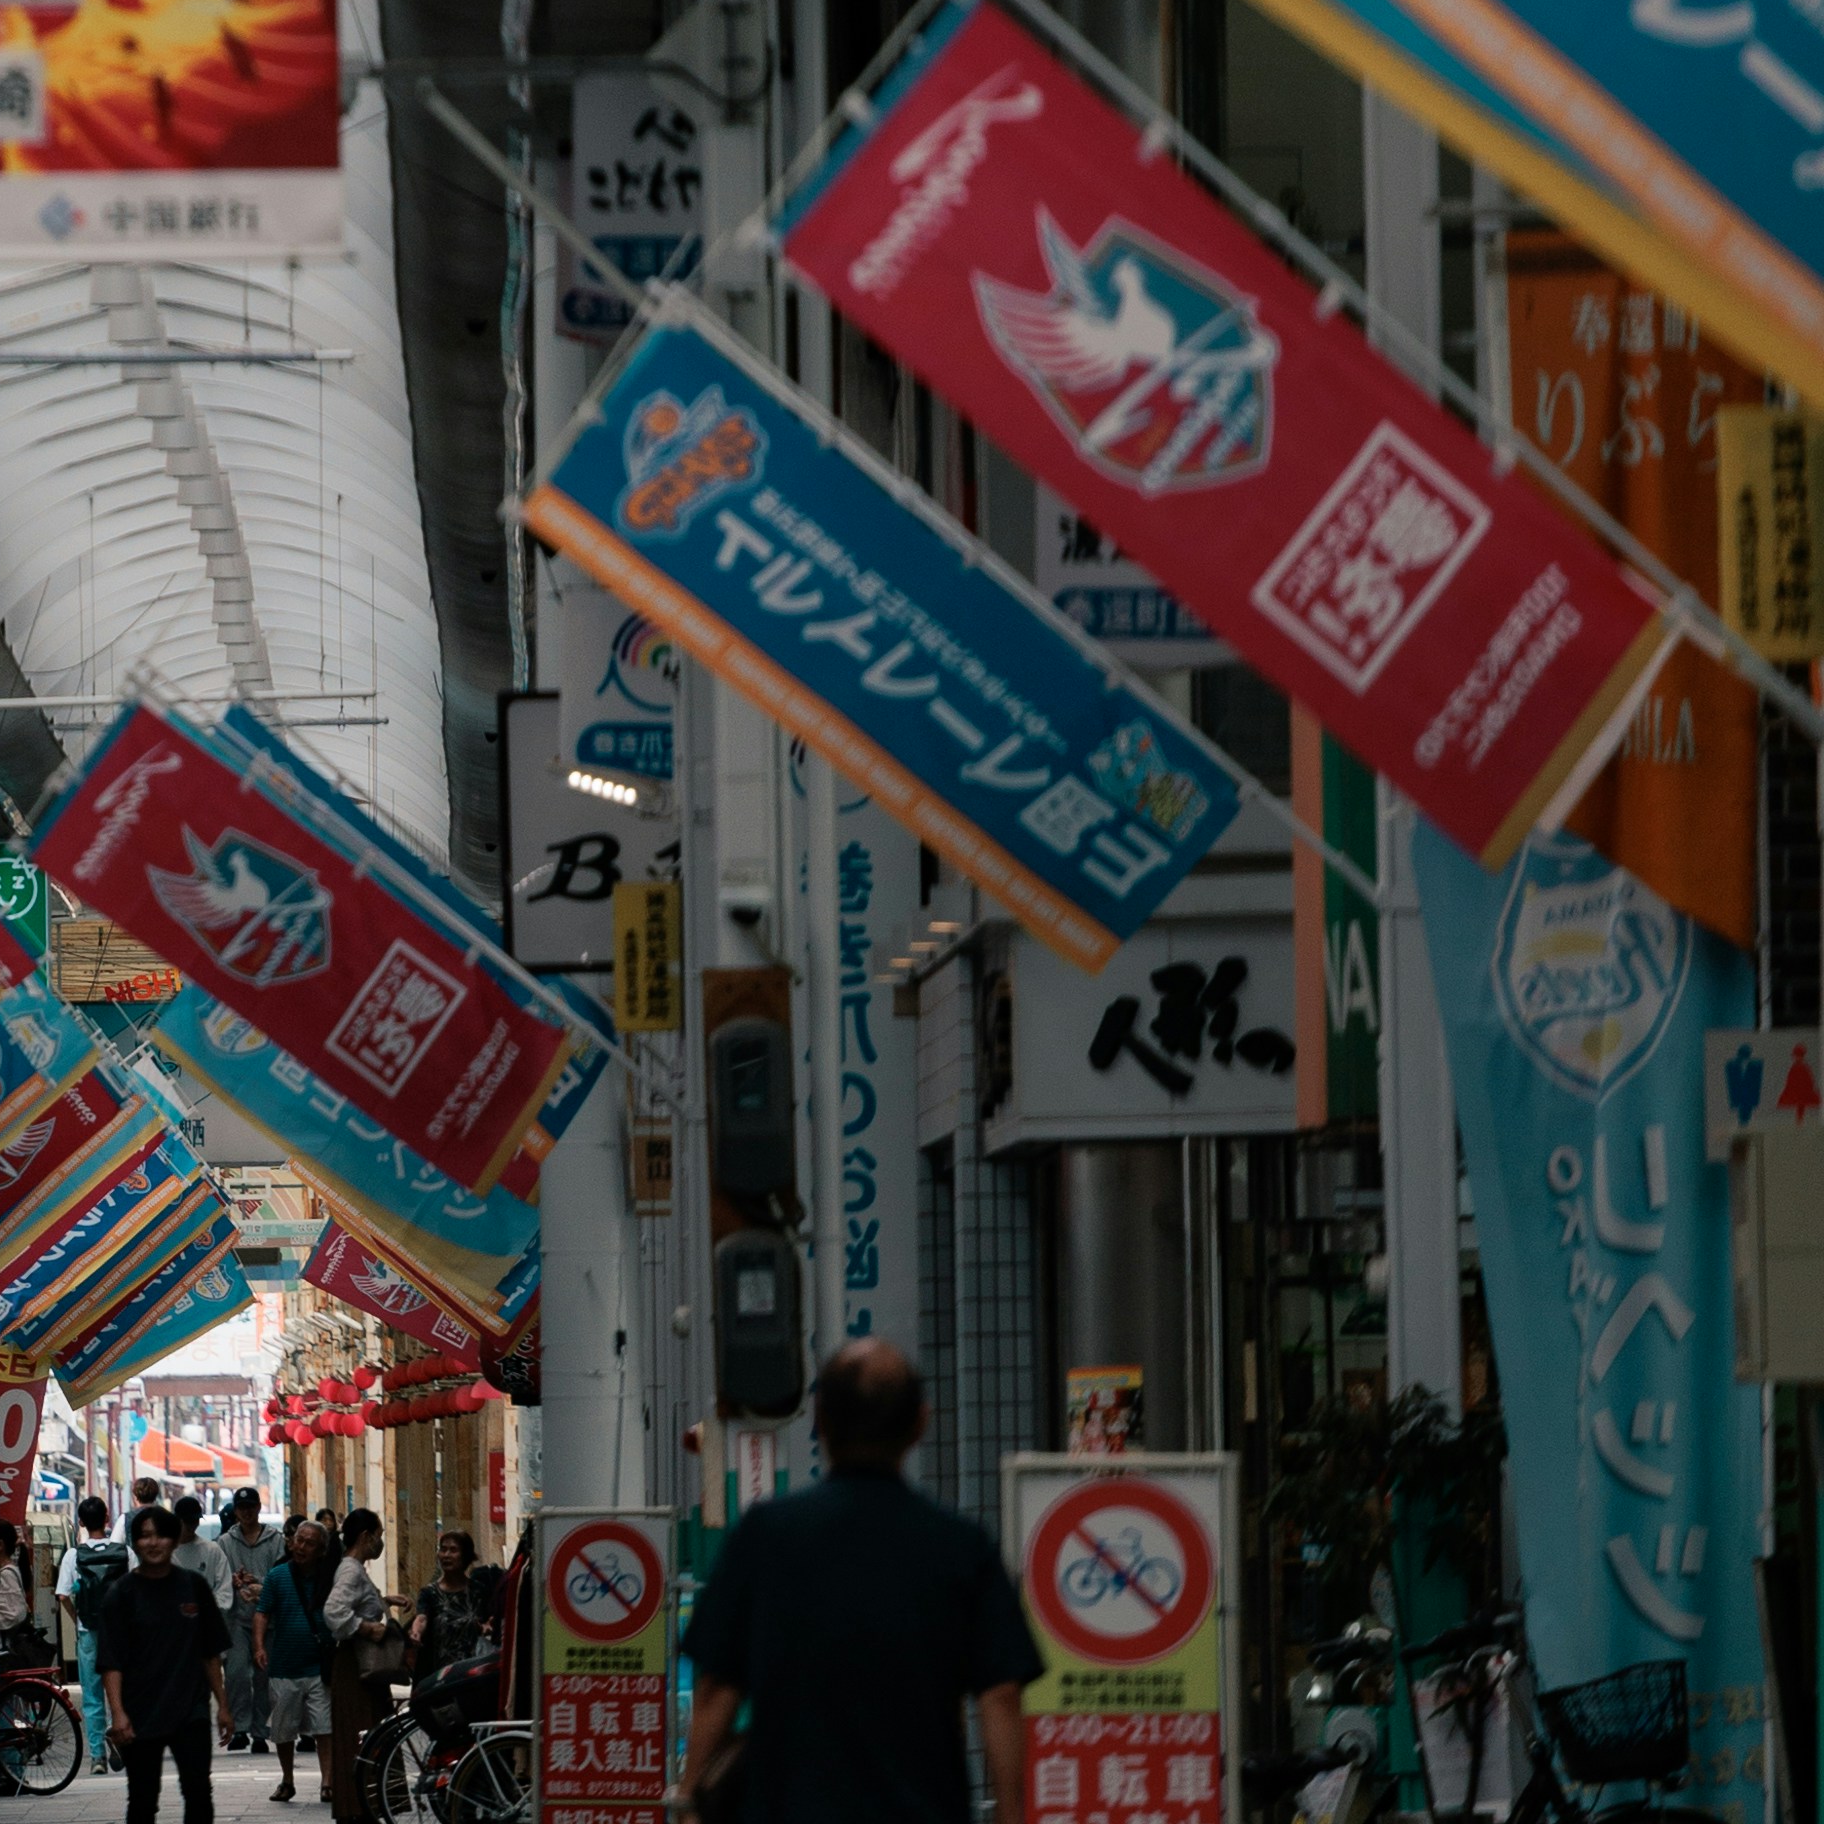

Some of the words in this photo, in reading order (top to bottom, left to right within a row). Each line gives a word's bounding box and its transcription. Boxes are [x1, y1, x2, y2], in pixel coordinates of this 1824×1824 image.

[549, 1701, 663, 1736] 自転車
[548, 1738, 663, 1774] 乗入禁止
[1033, 1753, 1216, 1808] 自転車
